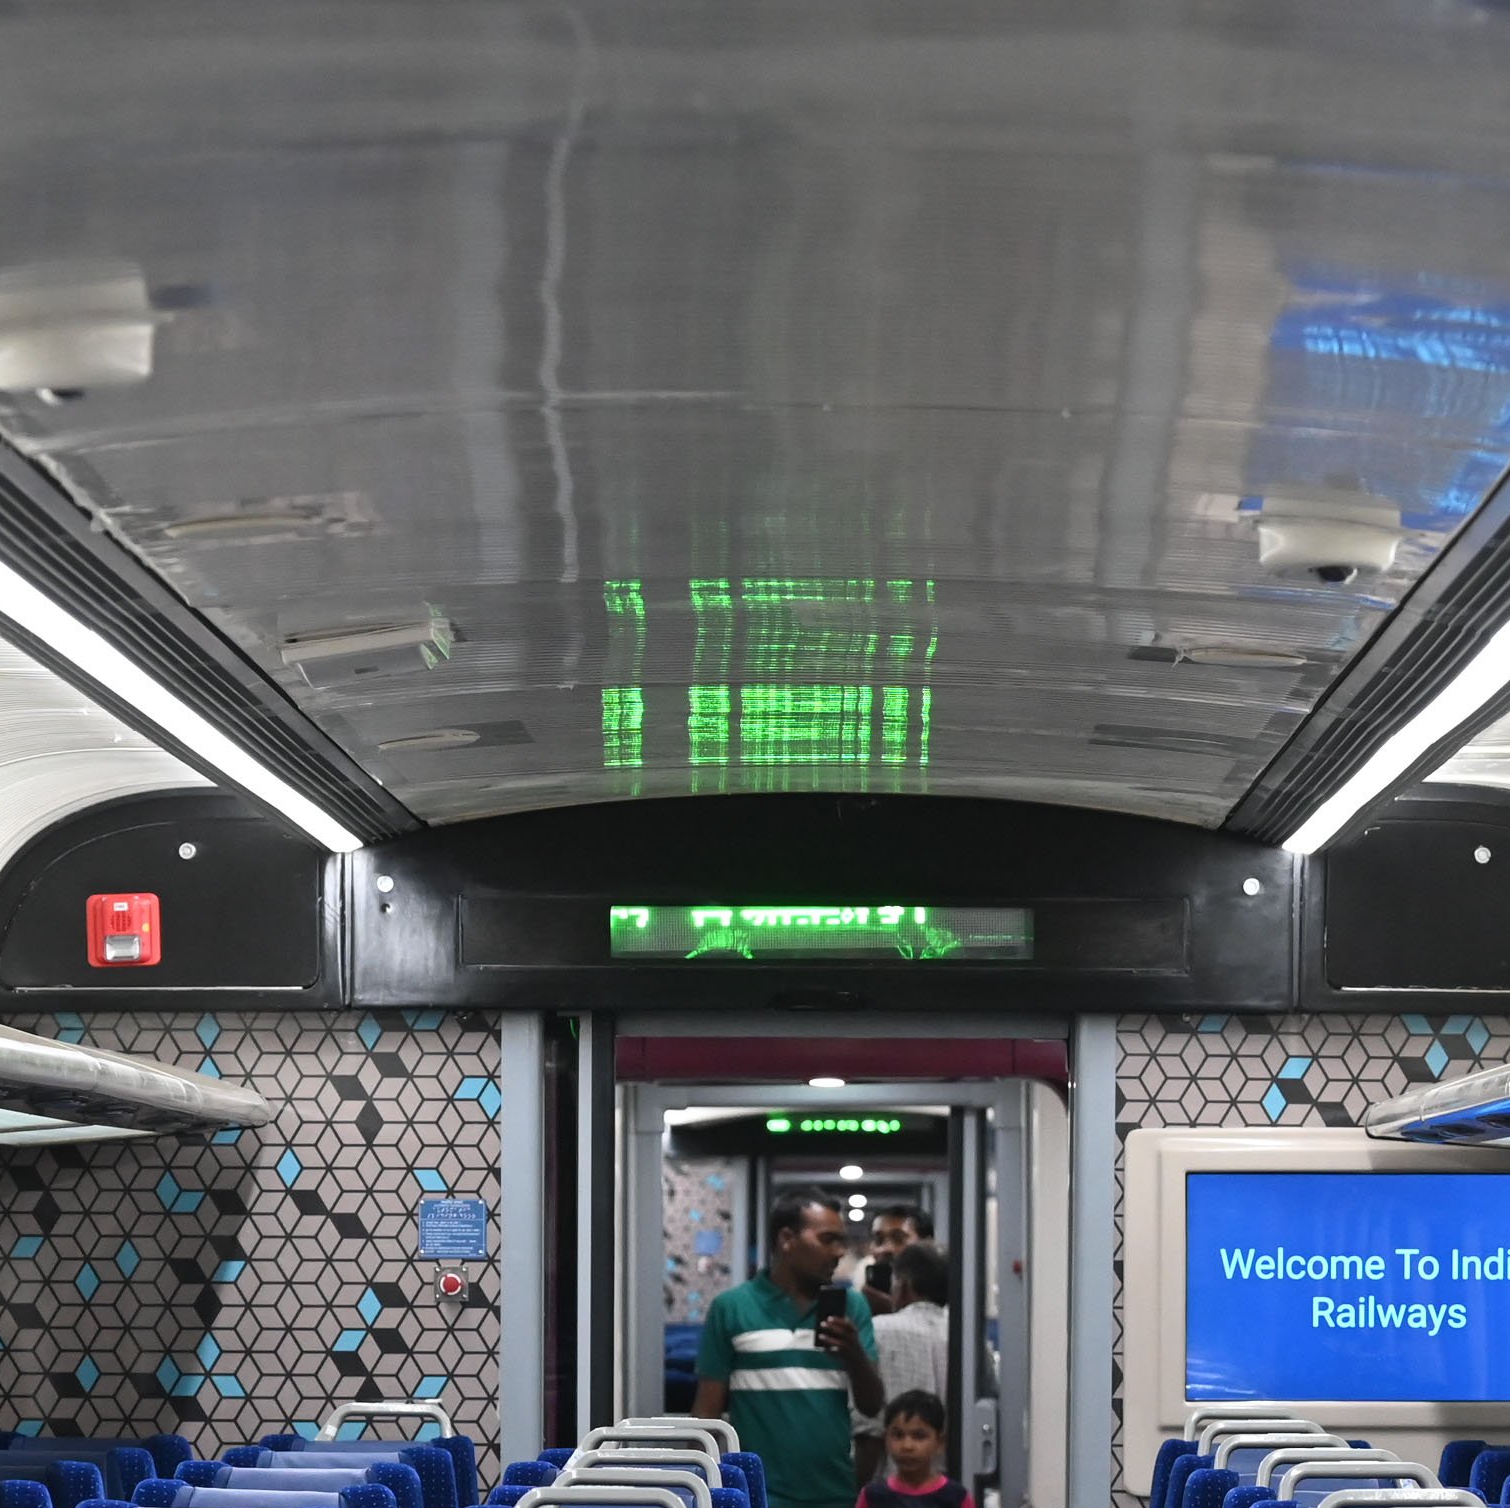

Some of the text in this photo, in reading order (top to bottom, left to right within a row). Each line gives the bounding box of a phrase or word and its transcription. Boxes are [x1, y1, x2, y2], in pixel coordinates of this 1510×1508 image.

[1219, 1246, 1386, 1280] Welcome
[1394, 1248, 1440, 1280] To
[1312, 1295, 1467, 1337] Railways
